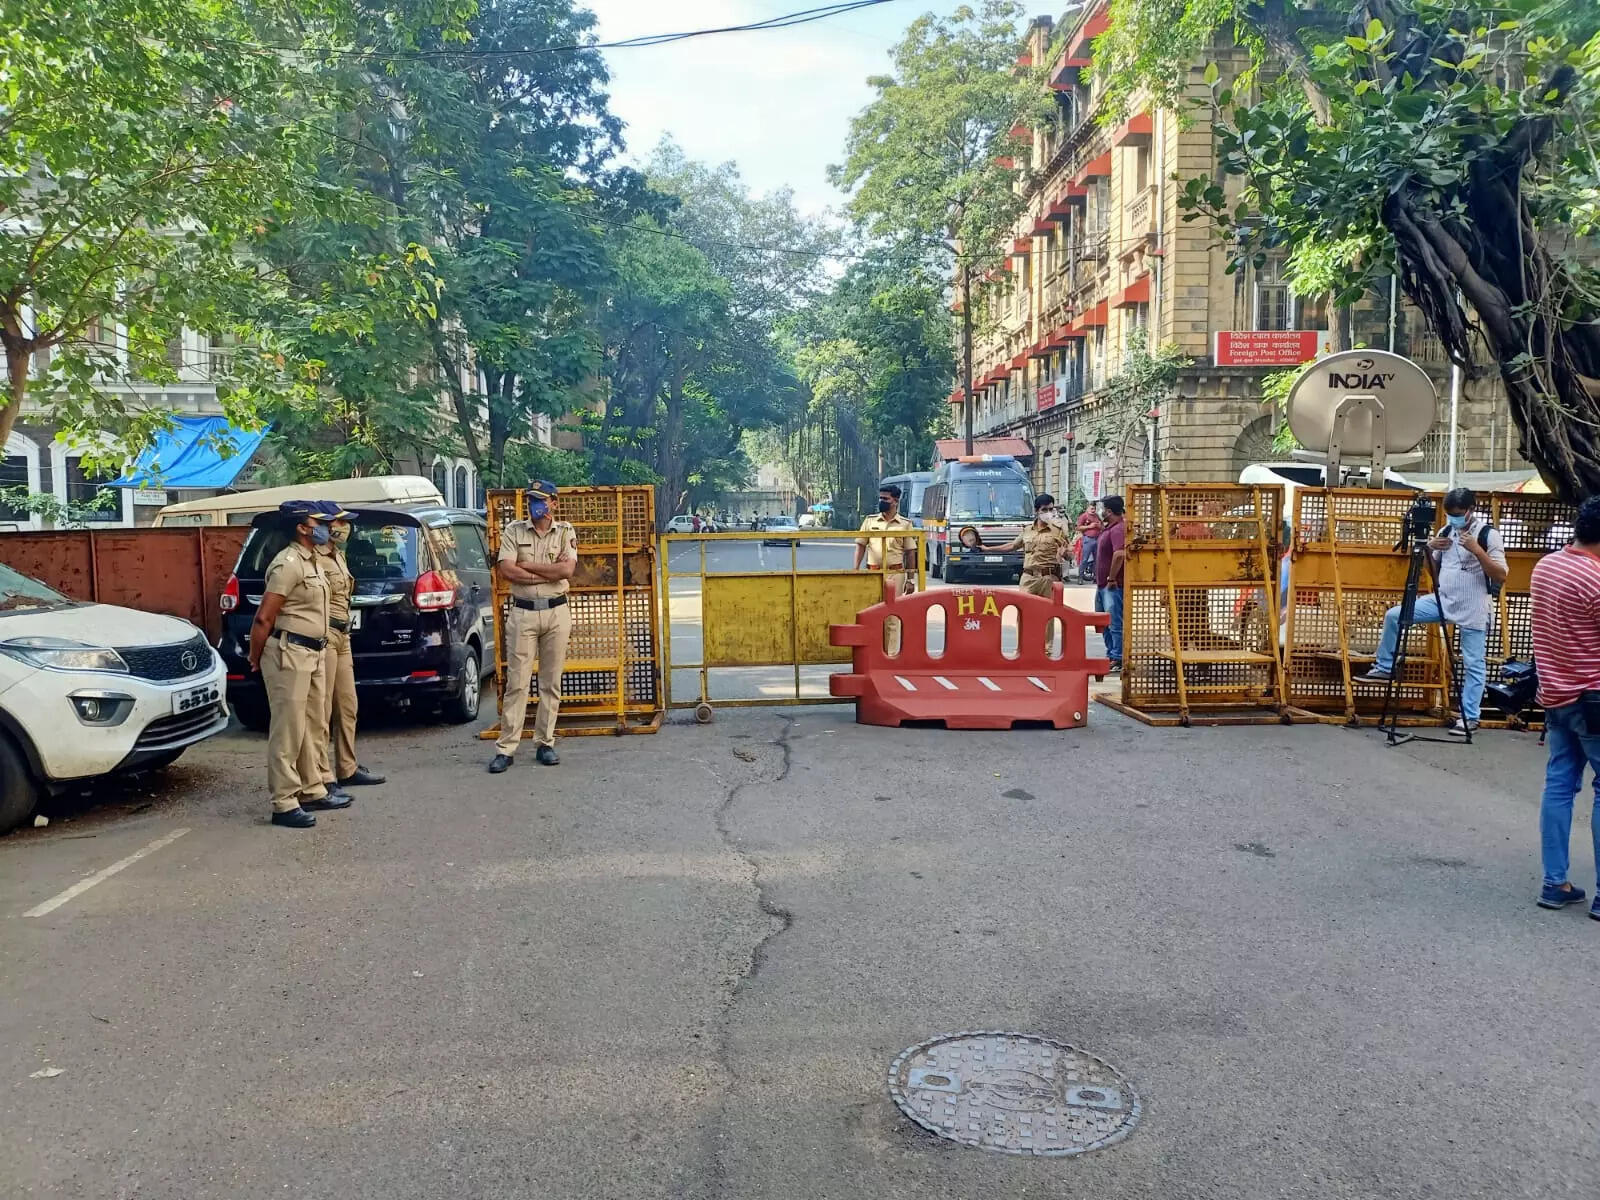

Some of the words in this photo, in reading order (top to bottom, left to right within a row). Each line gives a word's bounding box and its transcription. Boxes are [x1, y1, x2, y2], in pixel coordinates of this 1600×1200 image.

[1229, 349, 1258, 357] Foreign
[1328, 373, 1385, 389] INDIA
[1382, 373, 1396, 381] TV
